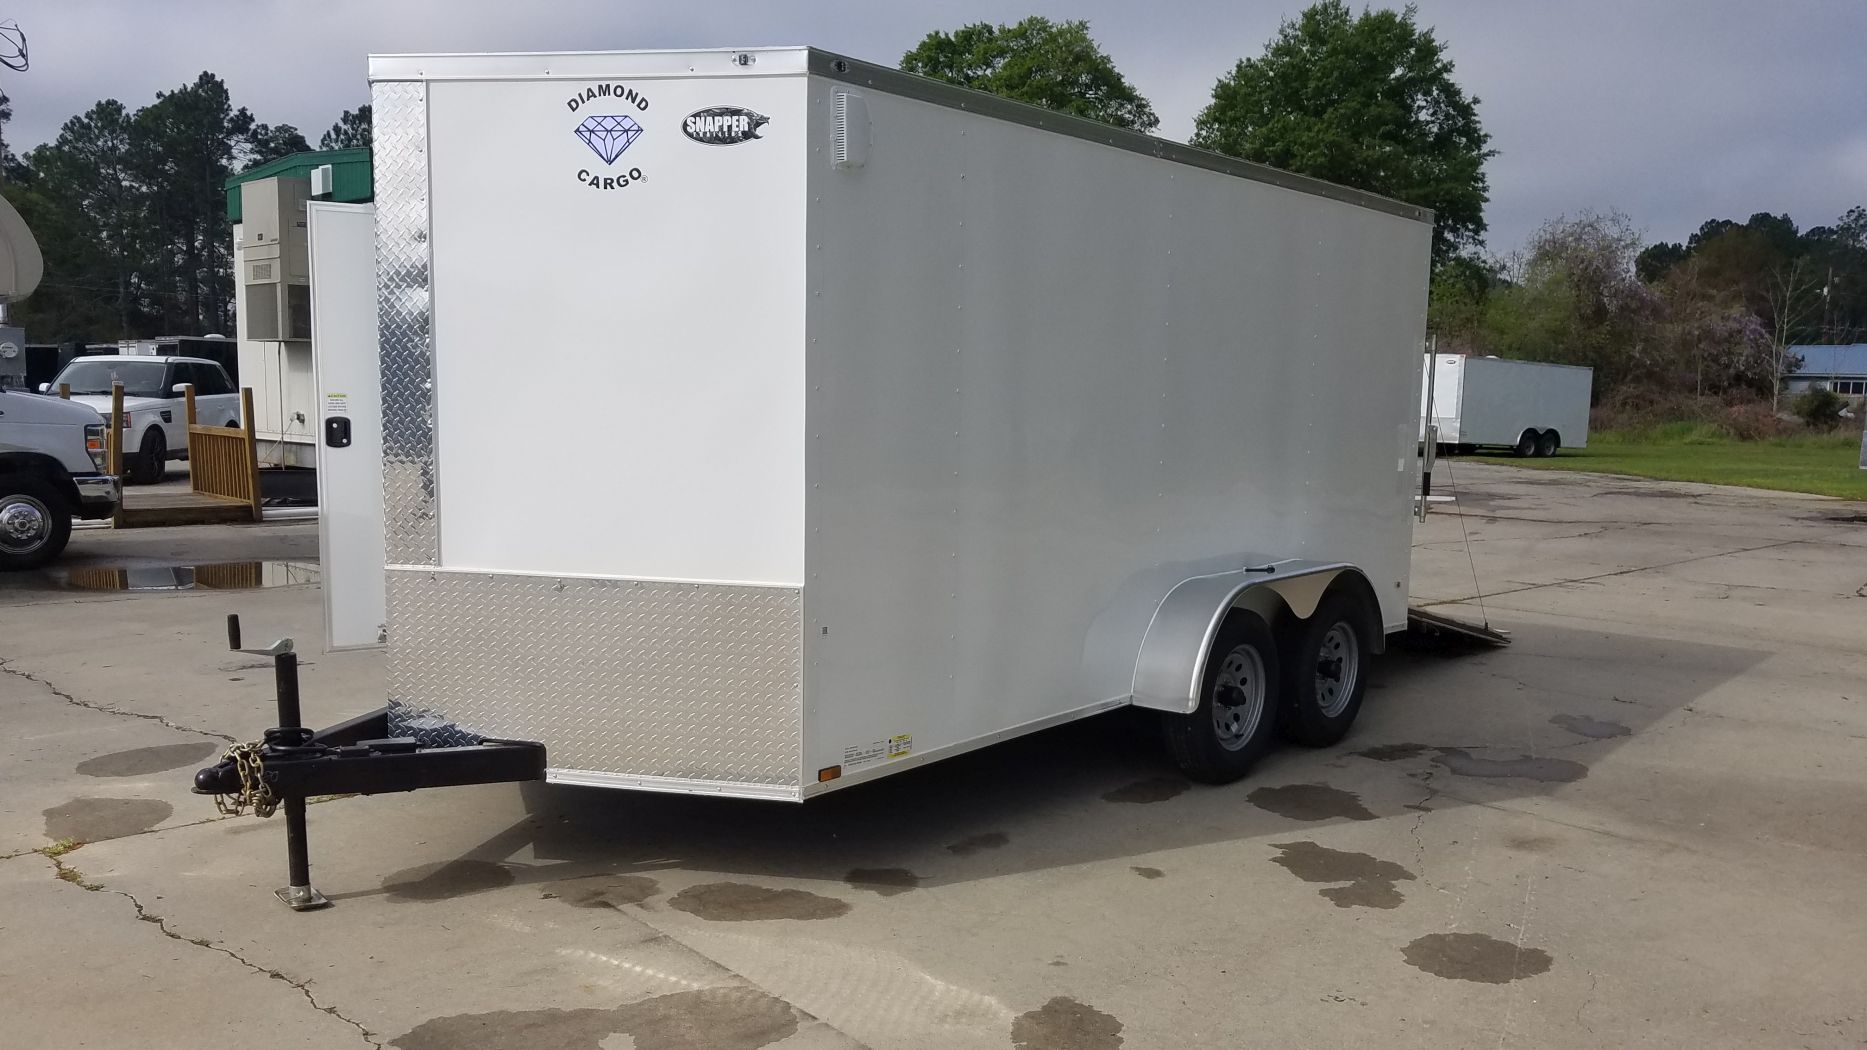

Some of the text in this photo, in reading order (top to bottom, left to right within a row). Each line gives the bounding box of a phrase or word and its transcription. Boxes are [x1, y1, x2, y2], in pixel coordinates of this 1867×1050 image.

[567, 84, 649, 112] DIAMOND
[686, 115, 749, 133] SNAPPER
[577, 167, 641, 190] CARGO
